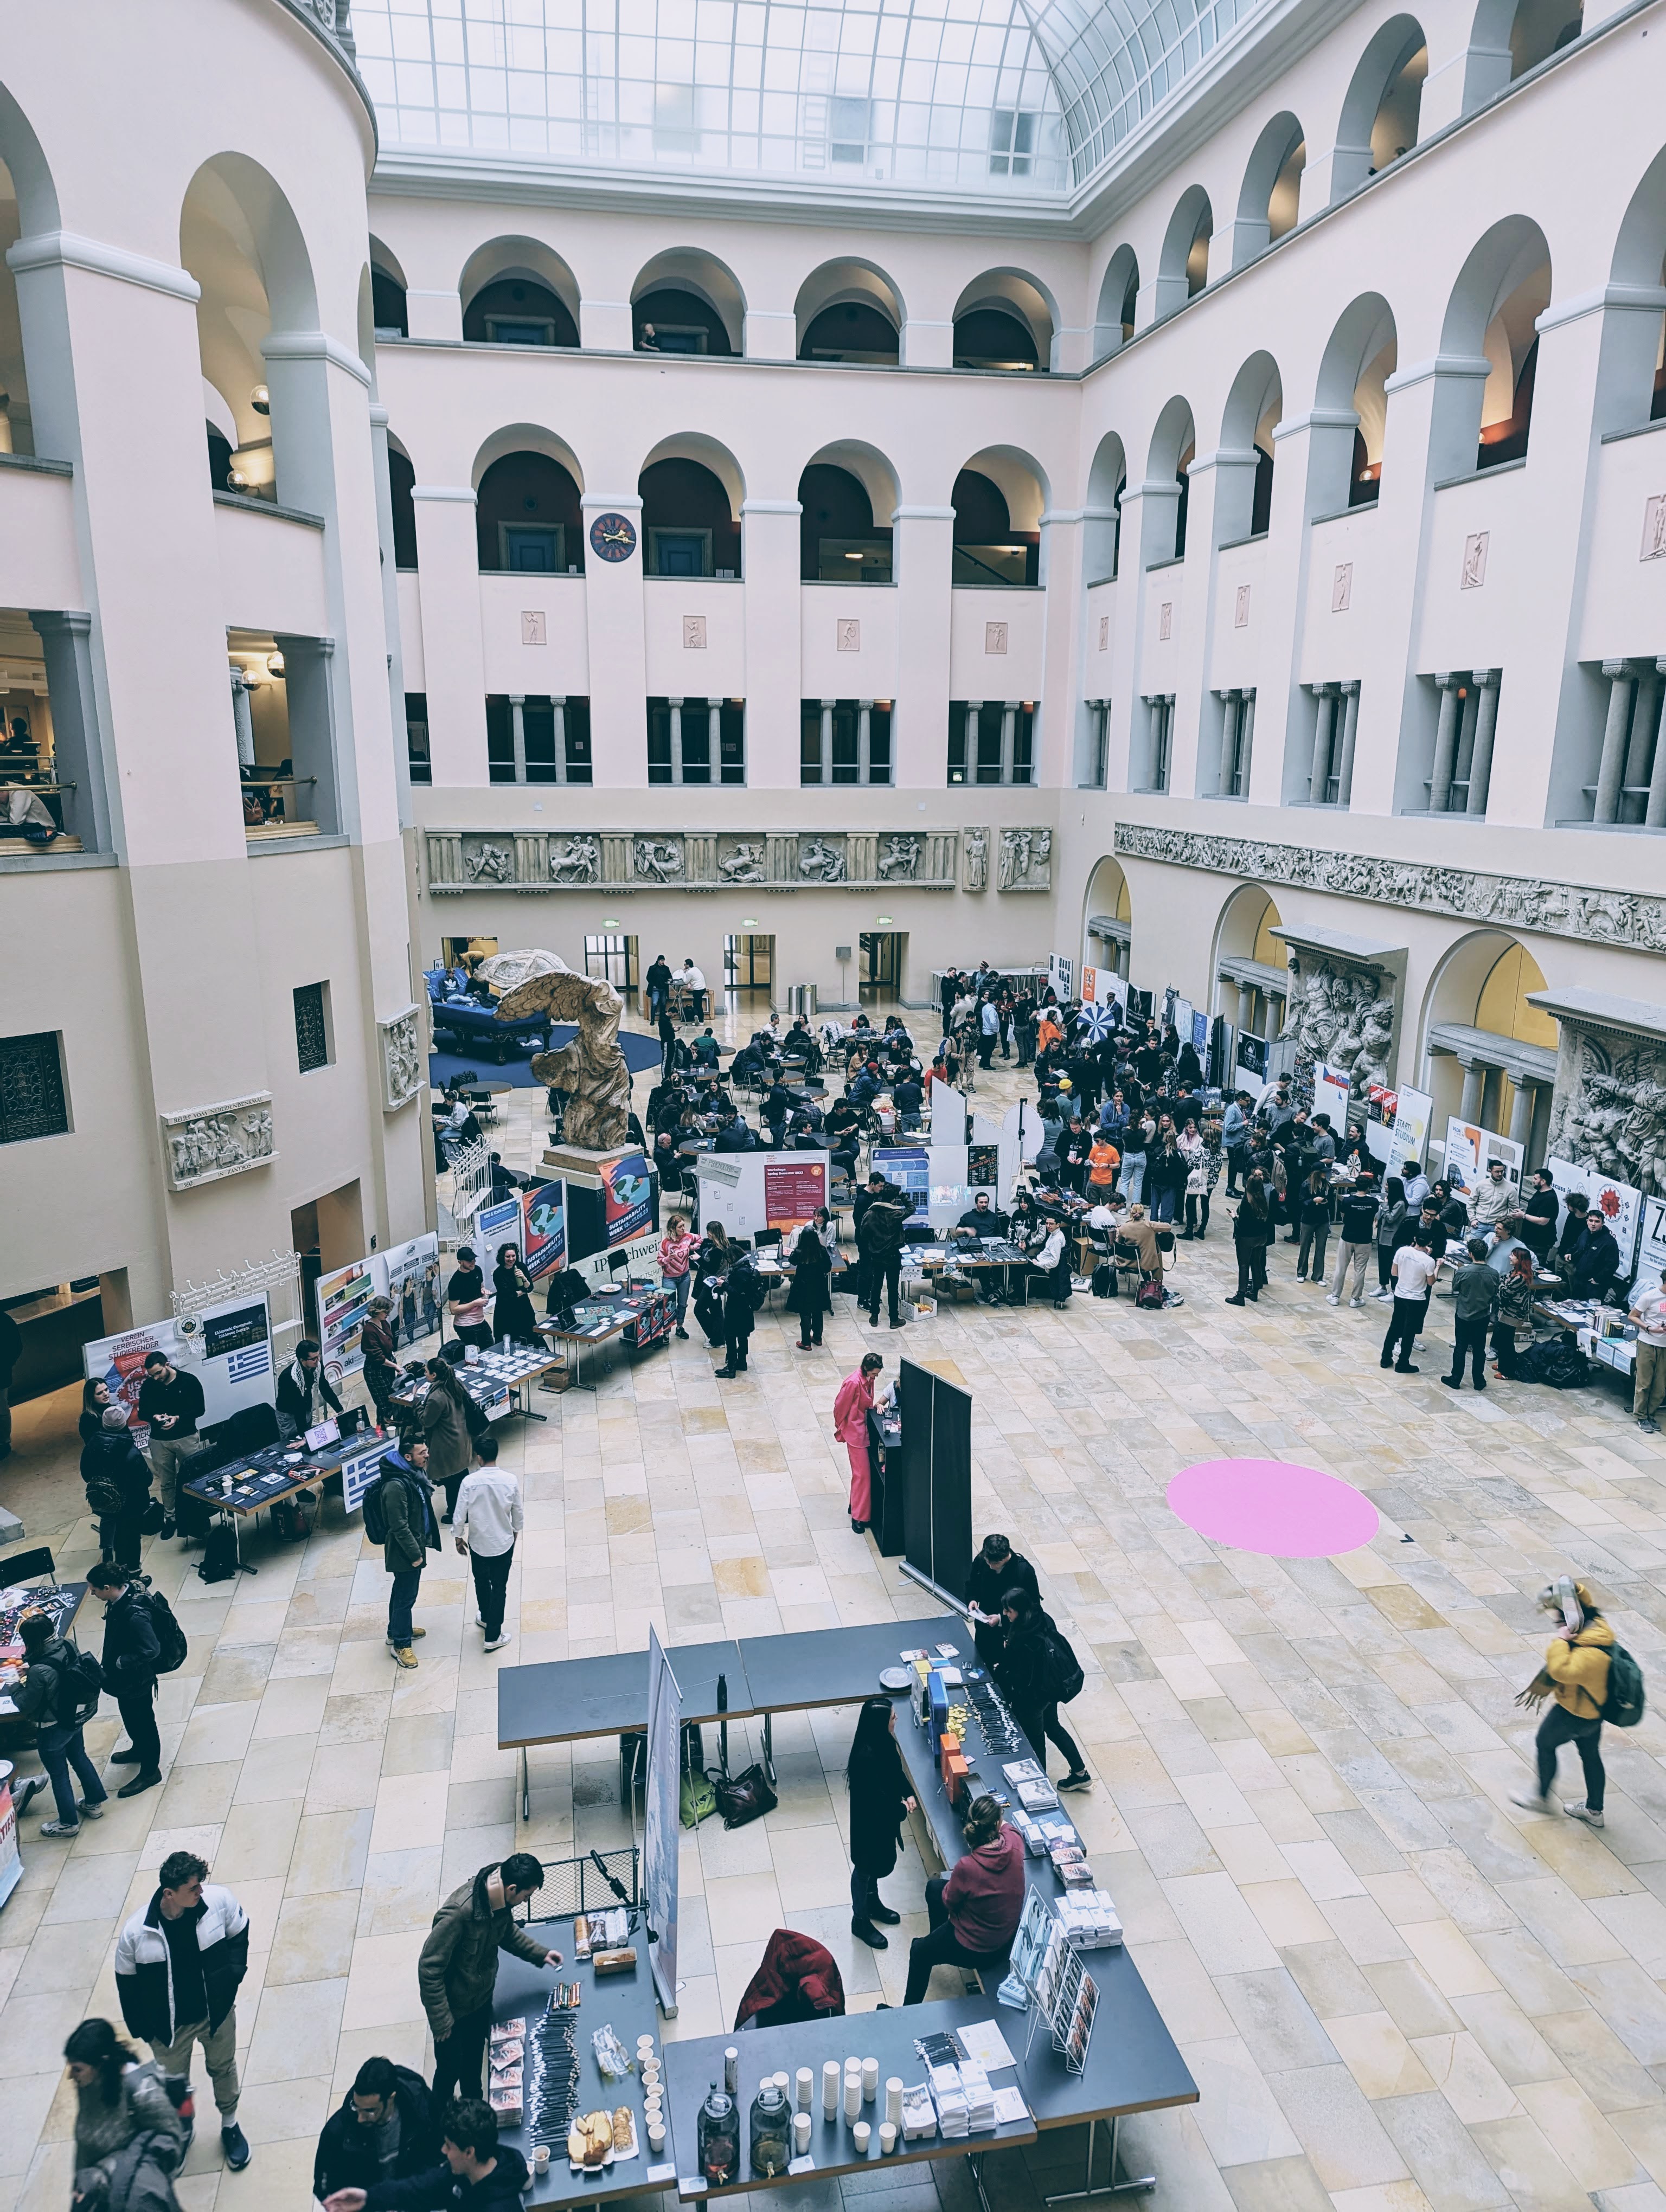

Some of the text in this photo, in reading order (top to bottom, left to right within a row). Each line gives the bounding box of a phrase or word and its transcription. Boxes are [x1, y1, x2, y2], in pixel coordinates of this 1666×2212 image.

[1397, 1118, 1412, 1133] START!
[1395, 1128, 1415, 1146] STUDIUM
[608, 1203, 646, 1230] SUSTAINABILITY
[609, 1225, 624, 1237] WEEK
[527, 1232, 561, 1264] SUSTAINABILITY
[527, 1258, 541, 1271] WEEK
[593, 1258, 608, 1273] IP
[112, 1335, 154, 1352] SERBISCHER
[121, 1332, 144, 1342] VEREIN
[108, 1341, 158, 1360] STUDIERENDER
[344, 1355, 354, 1367] aki
[0, 1811, 15, 1841] TIEN
